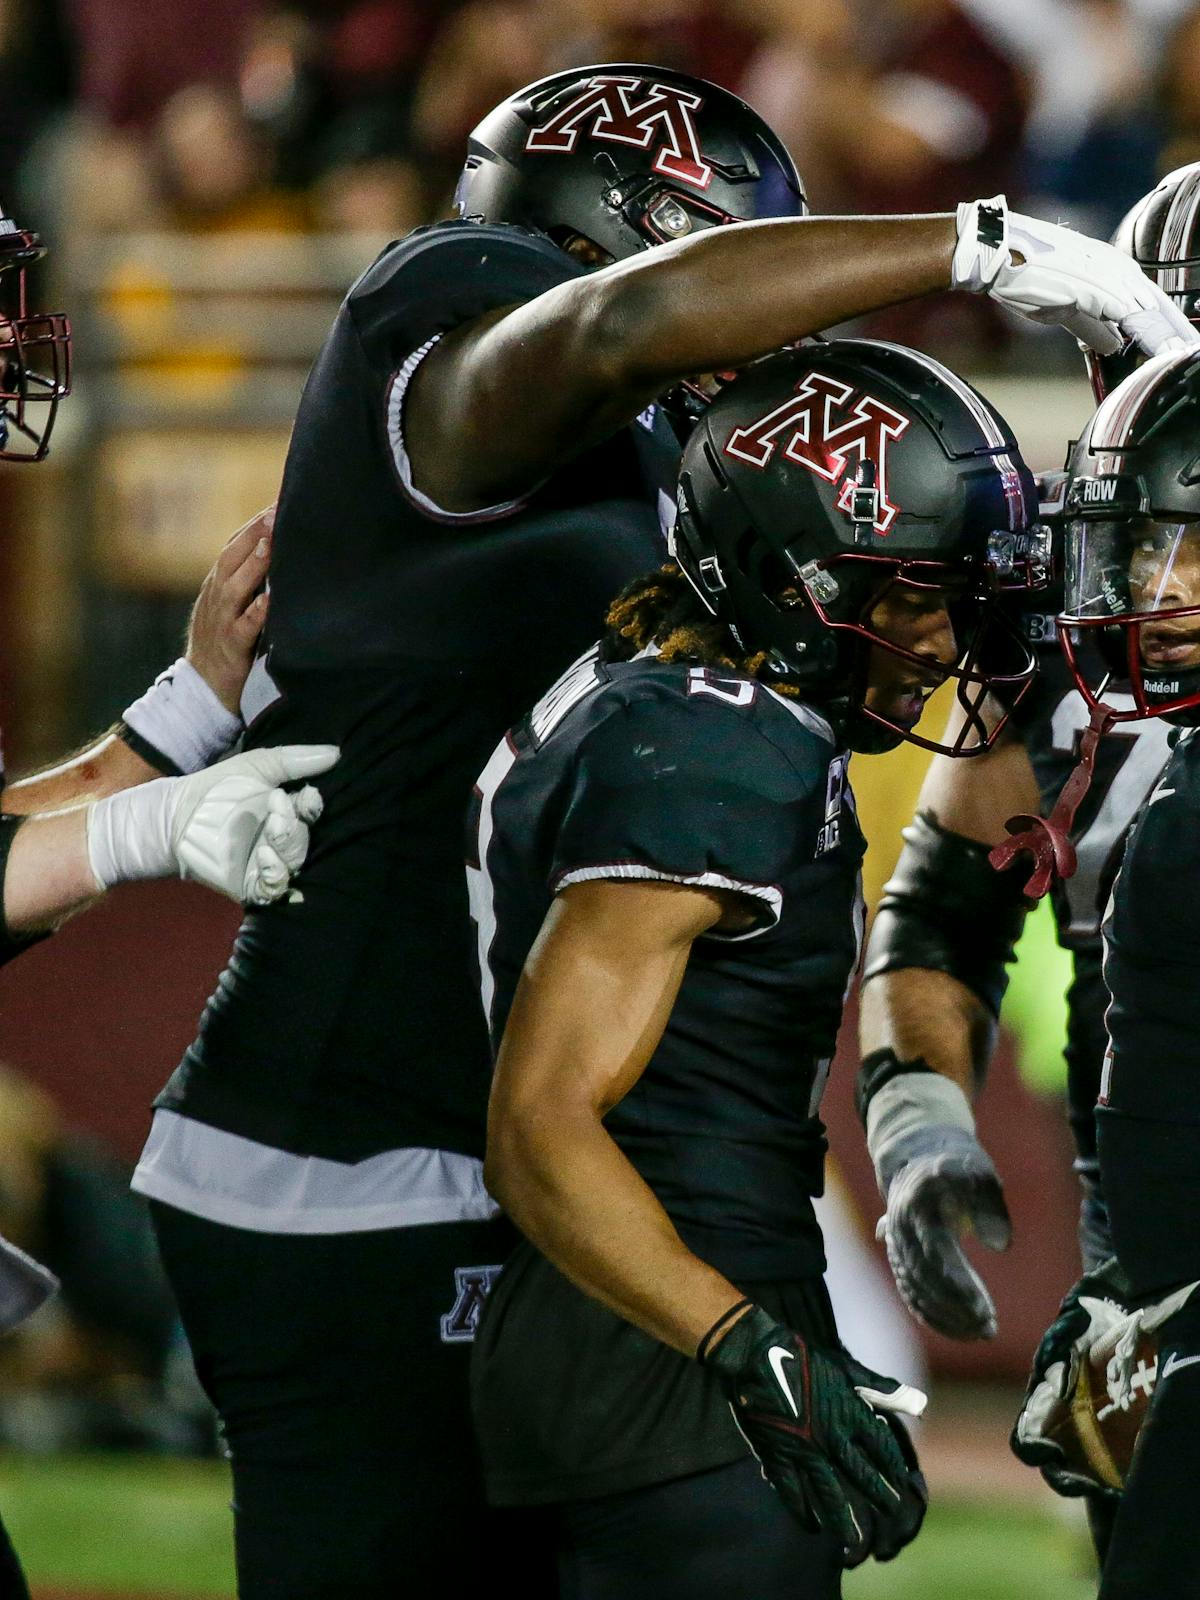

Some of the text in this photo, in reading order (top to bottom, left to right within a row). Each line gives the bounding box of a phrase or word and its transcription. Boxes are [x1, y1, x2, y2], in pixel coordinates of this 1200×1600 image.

[526, 76, 713, 188] M
[724, 372, 909, 536] M
[1084, 480, 1118, 502] ROW
